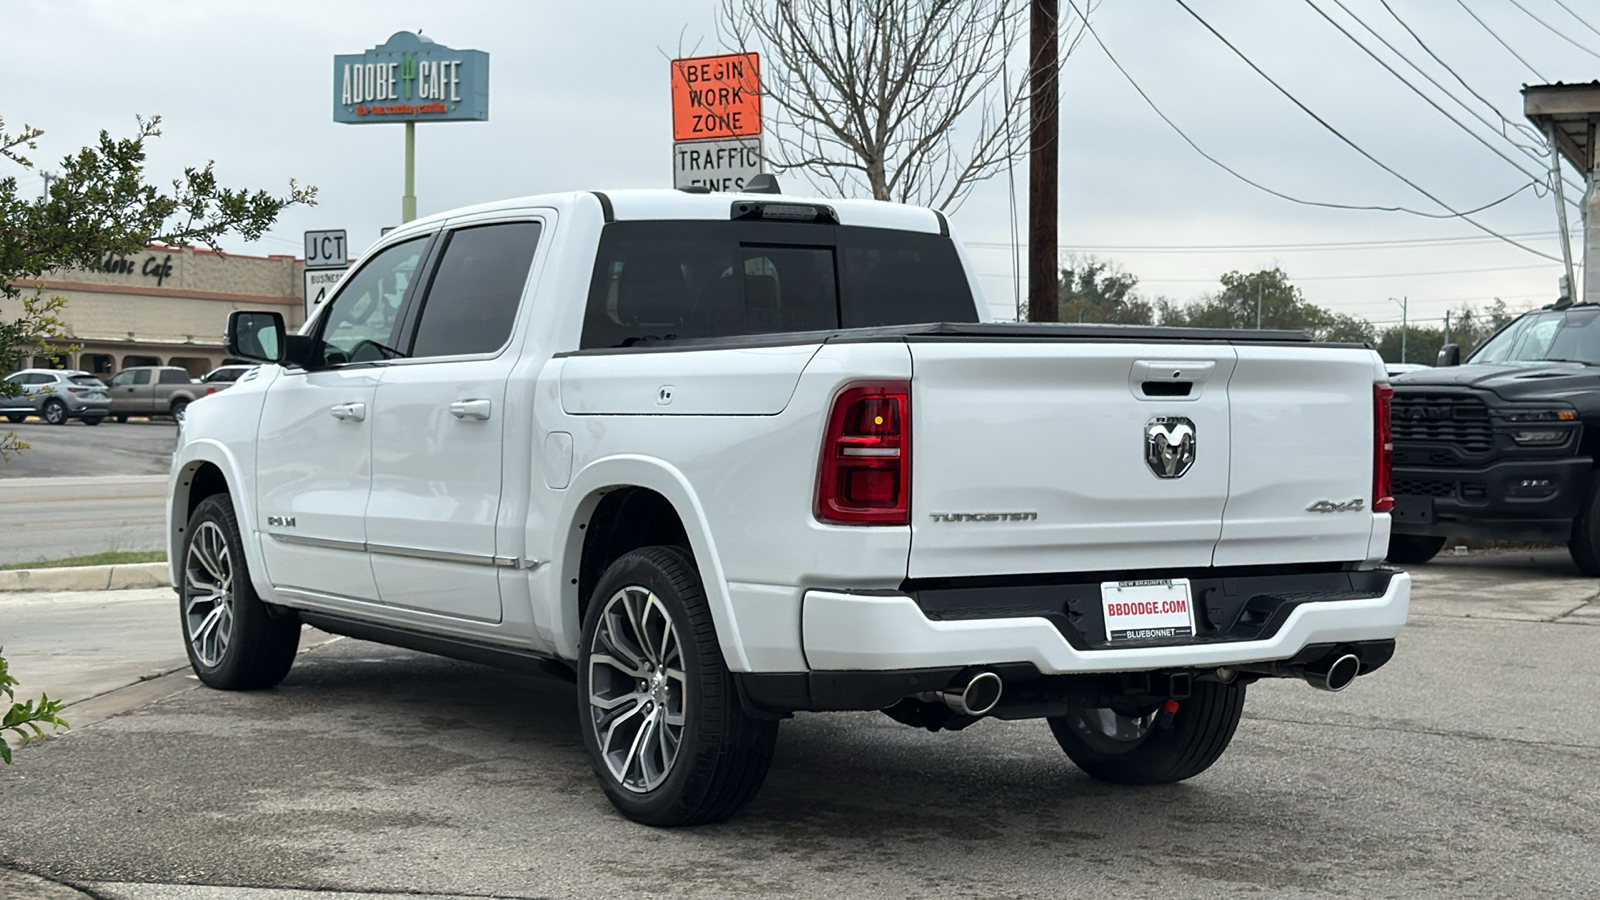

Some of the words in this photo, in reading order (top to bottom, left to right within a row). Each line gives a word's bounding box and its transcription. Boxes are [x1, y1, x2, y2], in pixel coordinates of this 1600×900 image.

[342, 62, 399, 105] ADOBE
[419, 60, 462, 102] CAFE
[687, 61, 744, 83] BEGIN
[689, 86, 744, 108] WORK
[692, 111, 744, 133] ZONE
[678, 146, 758, 171] TRAFFIC
[308, 236, 344, 261] JCT
[142, 254, 173, 287] Cafe
[929, 512, 1038, 522] TUNGSTEN
[1107, 600, 1187, 617] BBDODGE.COM
[1126, 628, 1176, 639] BLUEBONNET
